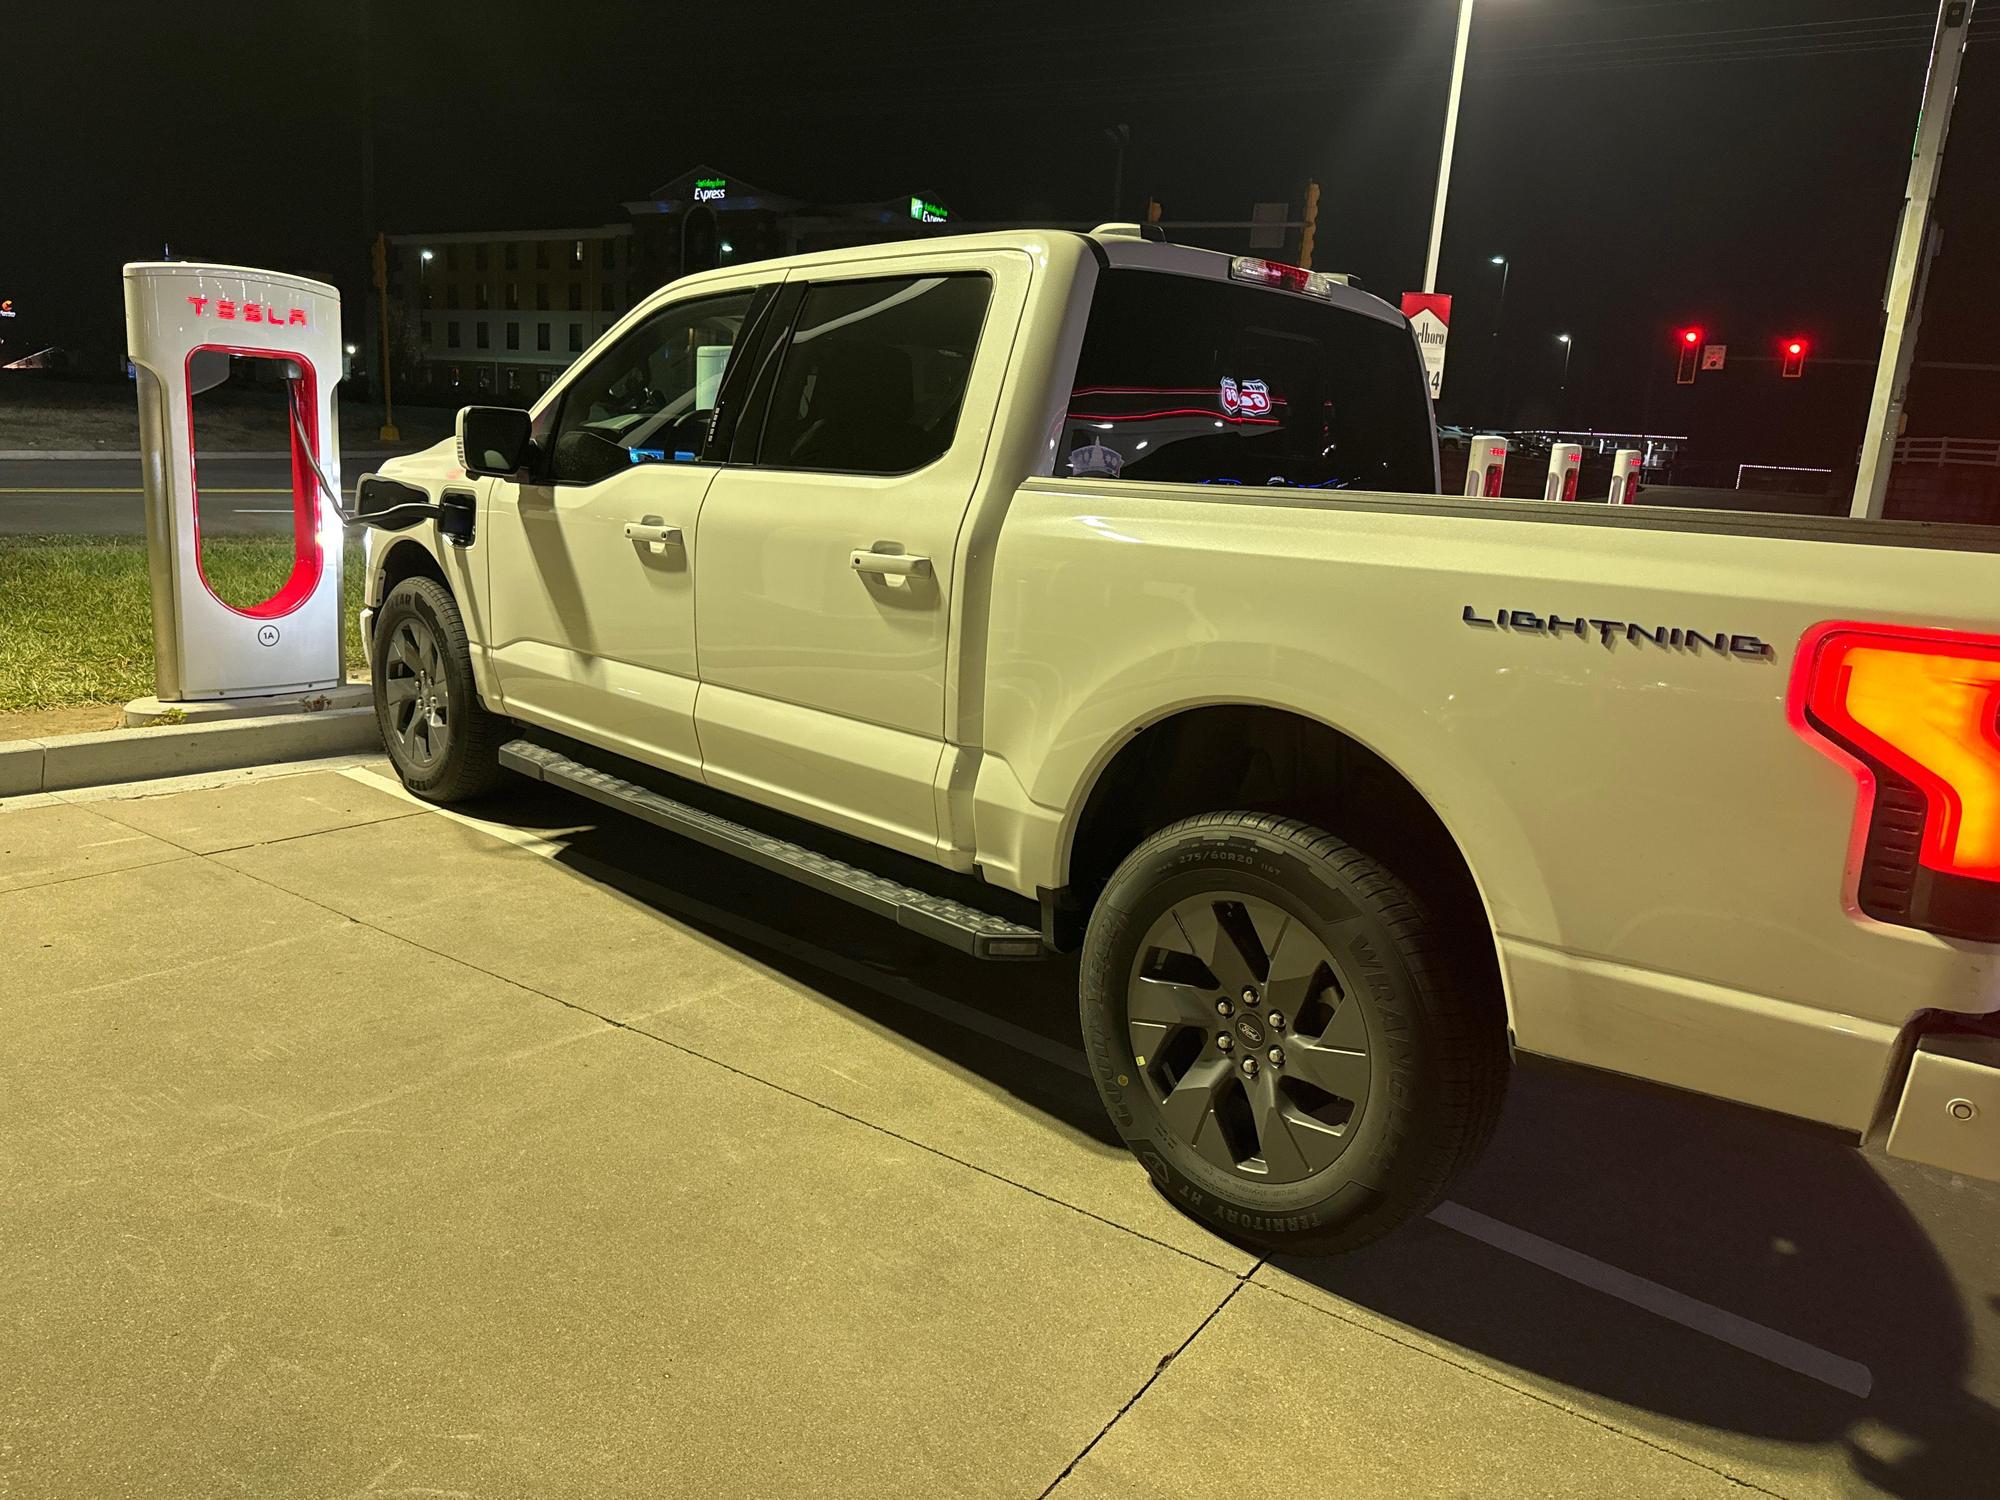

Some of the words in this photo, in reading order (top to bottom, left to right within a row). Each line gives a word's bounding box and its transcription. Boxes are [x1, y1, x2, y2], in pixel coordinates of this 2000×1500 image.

[694, 188, 725, 203] Express
[186, 296, 308, 328] TESLA
[1417, 322, 1445, 345] rlboro
[263, 632, 275, 640] 1A
[1462, 605, 1773, 658] LIGHTNING
[1178, 850, 1254, 865] 275/60R20
[1178, 1184, 1203, 1206] HT
[1214, 1204, 1322, 1233] TERRITORY
